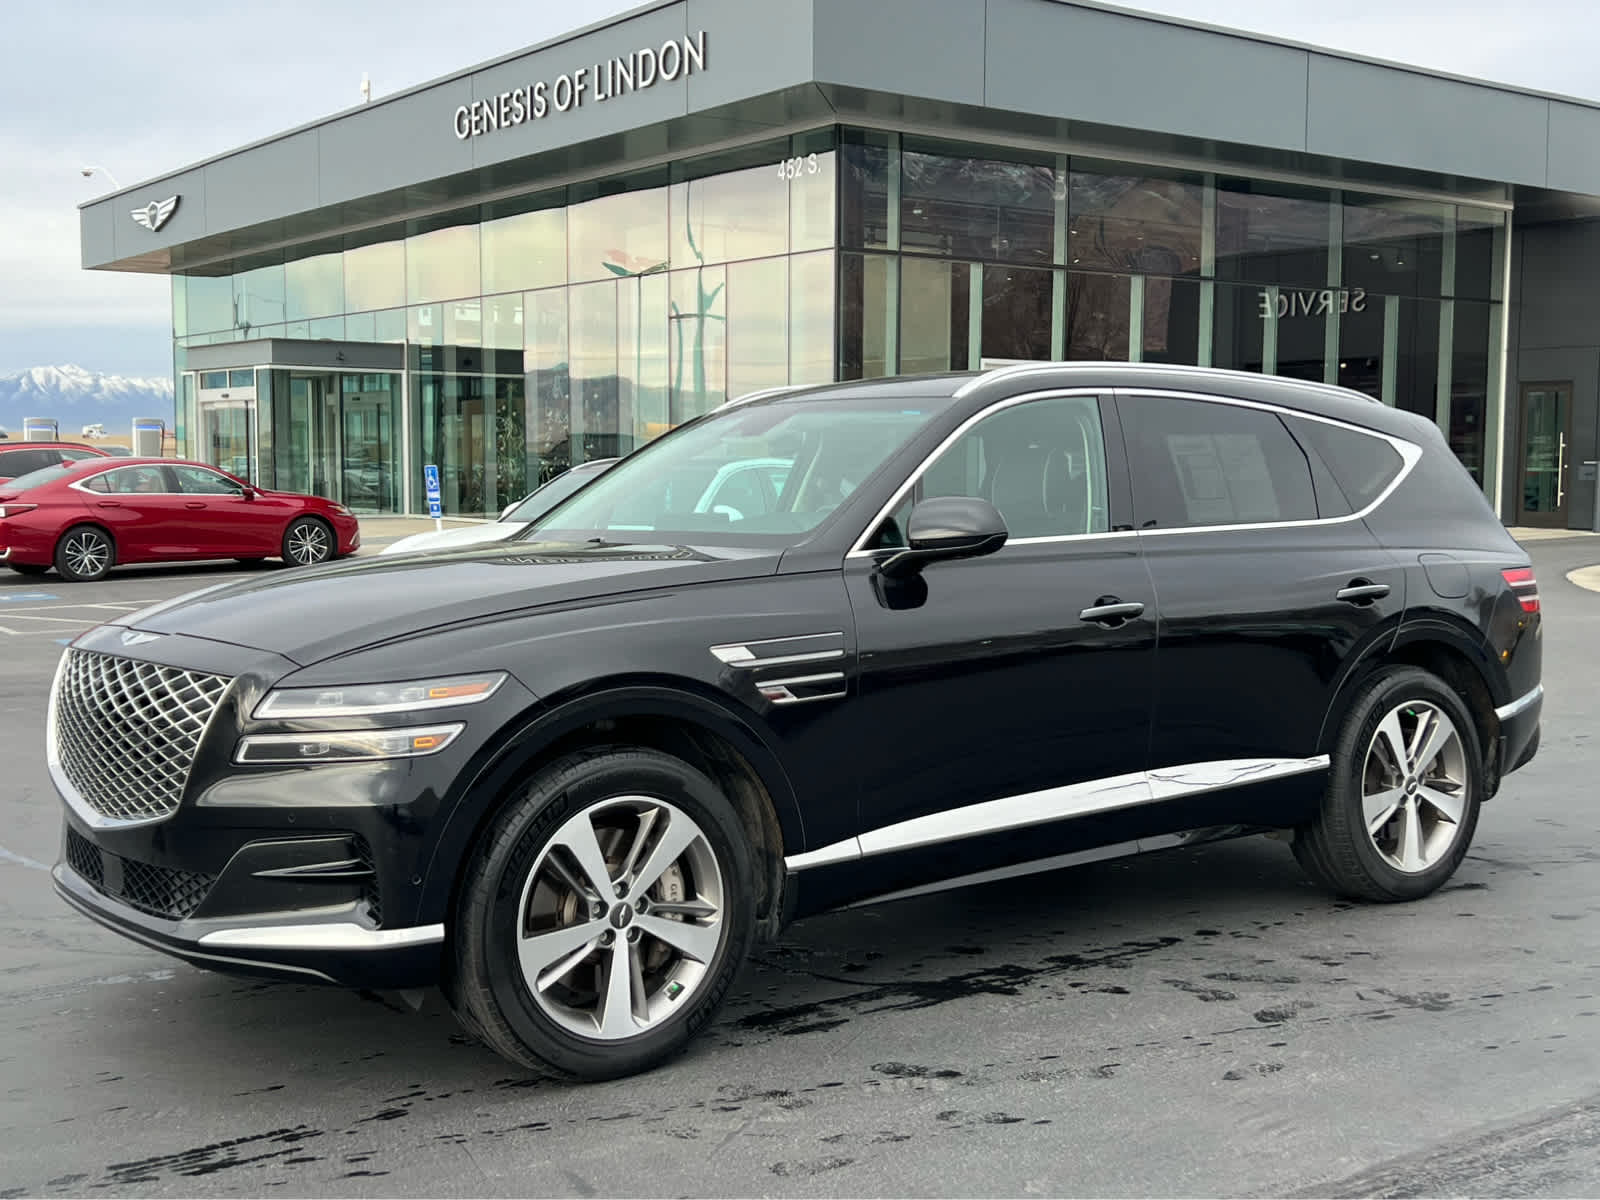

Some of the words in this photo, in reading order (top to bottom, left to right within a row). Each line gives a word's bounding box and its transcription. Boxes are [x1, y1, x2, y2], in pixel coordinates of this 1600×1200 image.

[454, 83, 548, 140] GENESIS
[553, 69, 588, 112] OF
[594, 31, 706, 102] LINDON
